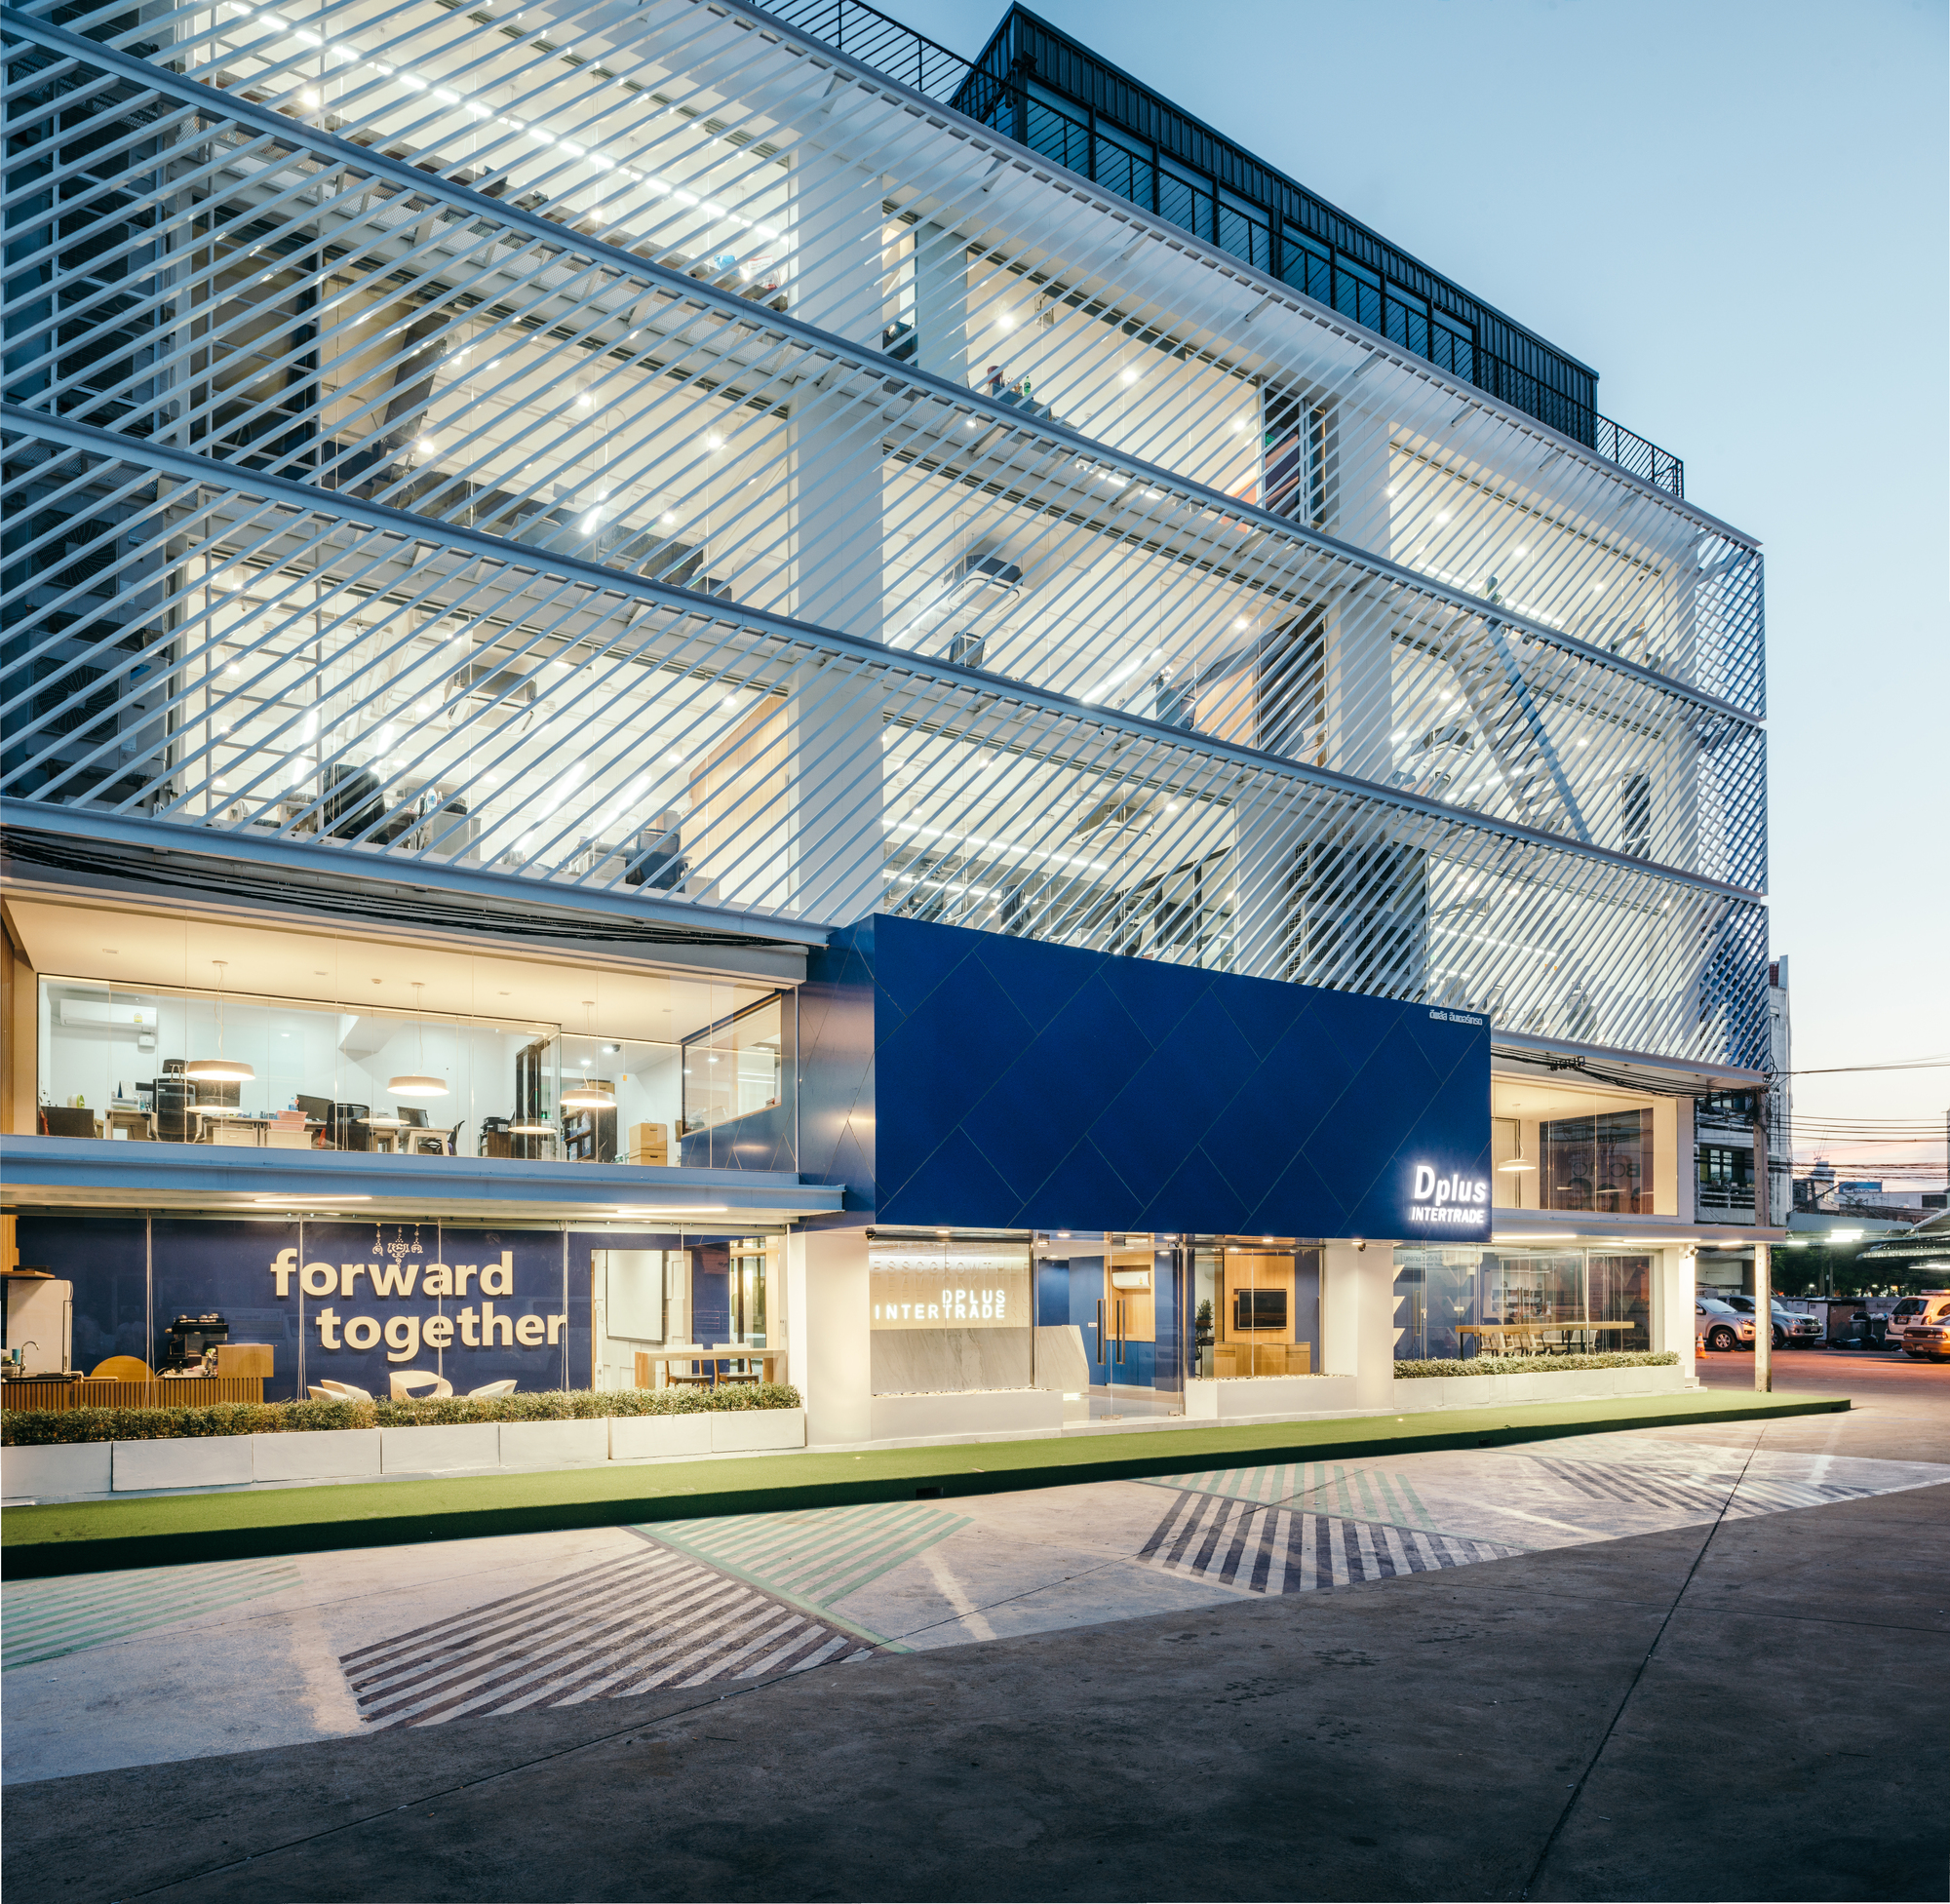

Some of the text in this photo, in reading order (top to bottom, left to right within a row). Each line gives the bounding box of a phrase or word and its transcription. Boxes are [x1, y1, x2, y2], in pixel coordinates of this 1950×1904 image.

[1413, 1165, 1487, 1207] Dplus
[1410, 1206, 1485, 1224] INTERTRADE
[270, 1248, 513, 1297] forward
[874, 1304, 1005, 1319] INTERTRADE
[942, 1290, 1006, 1304] DPLUS
[316, 1302, 567, 1362] together
